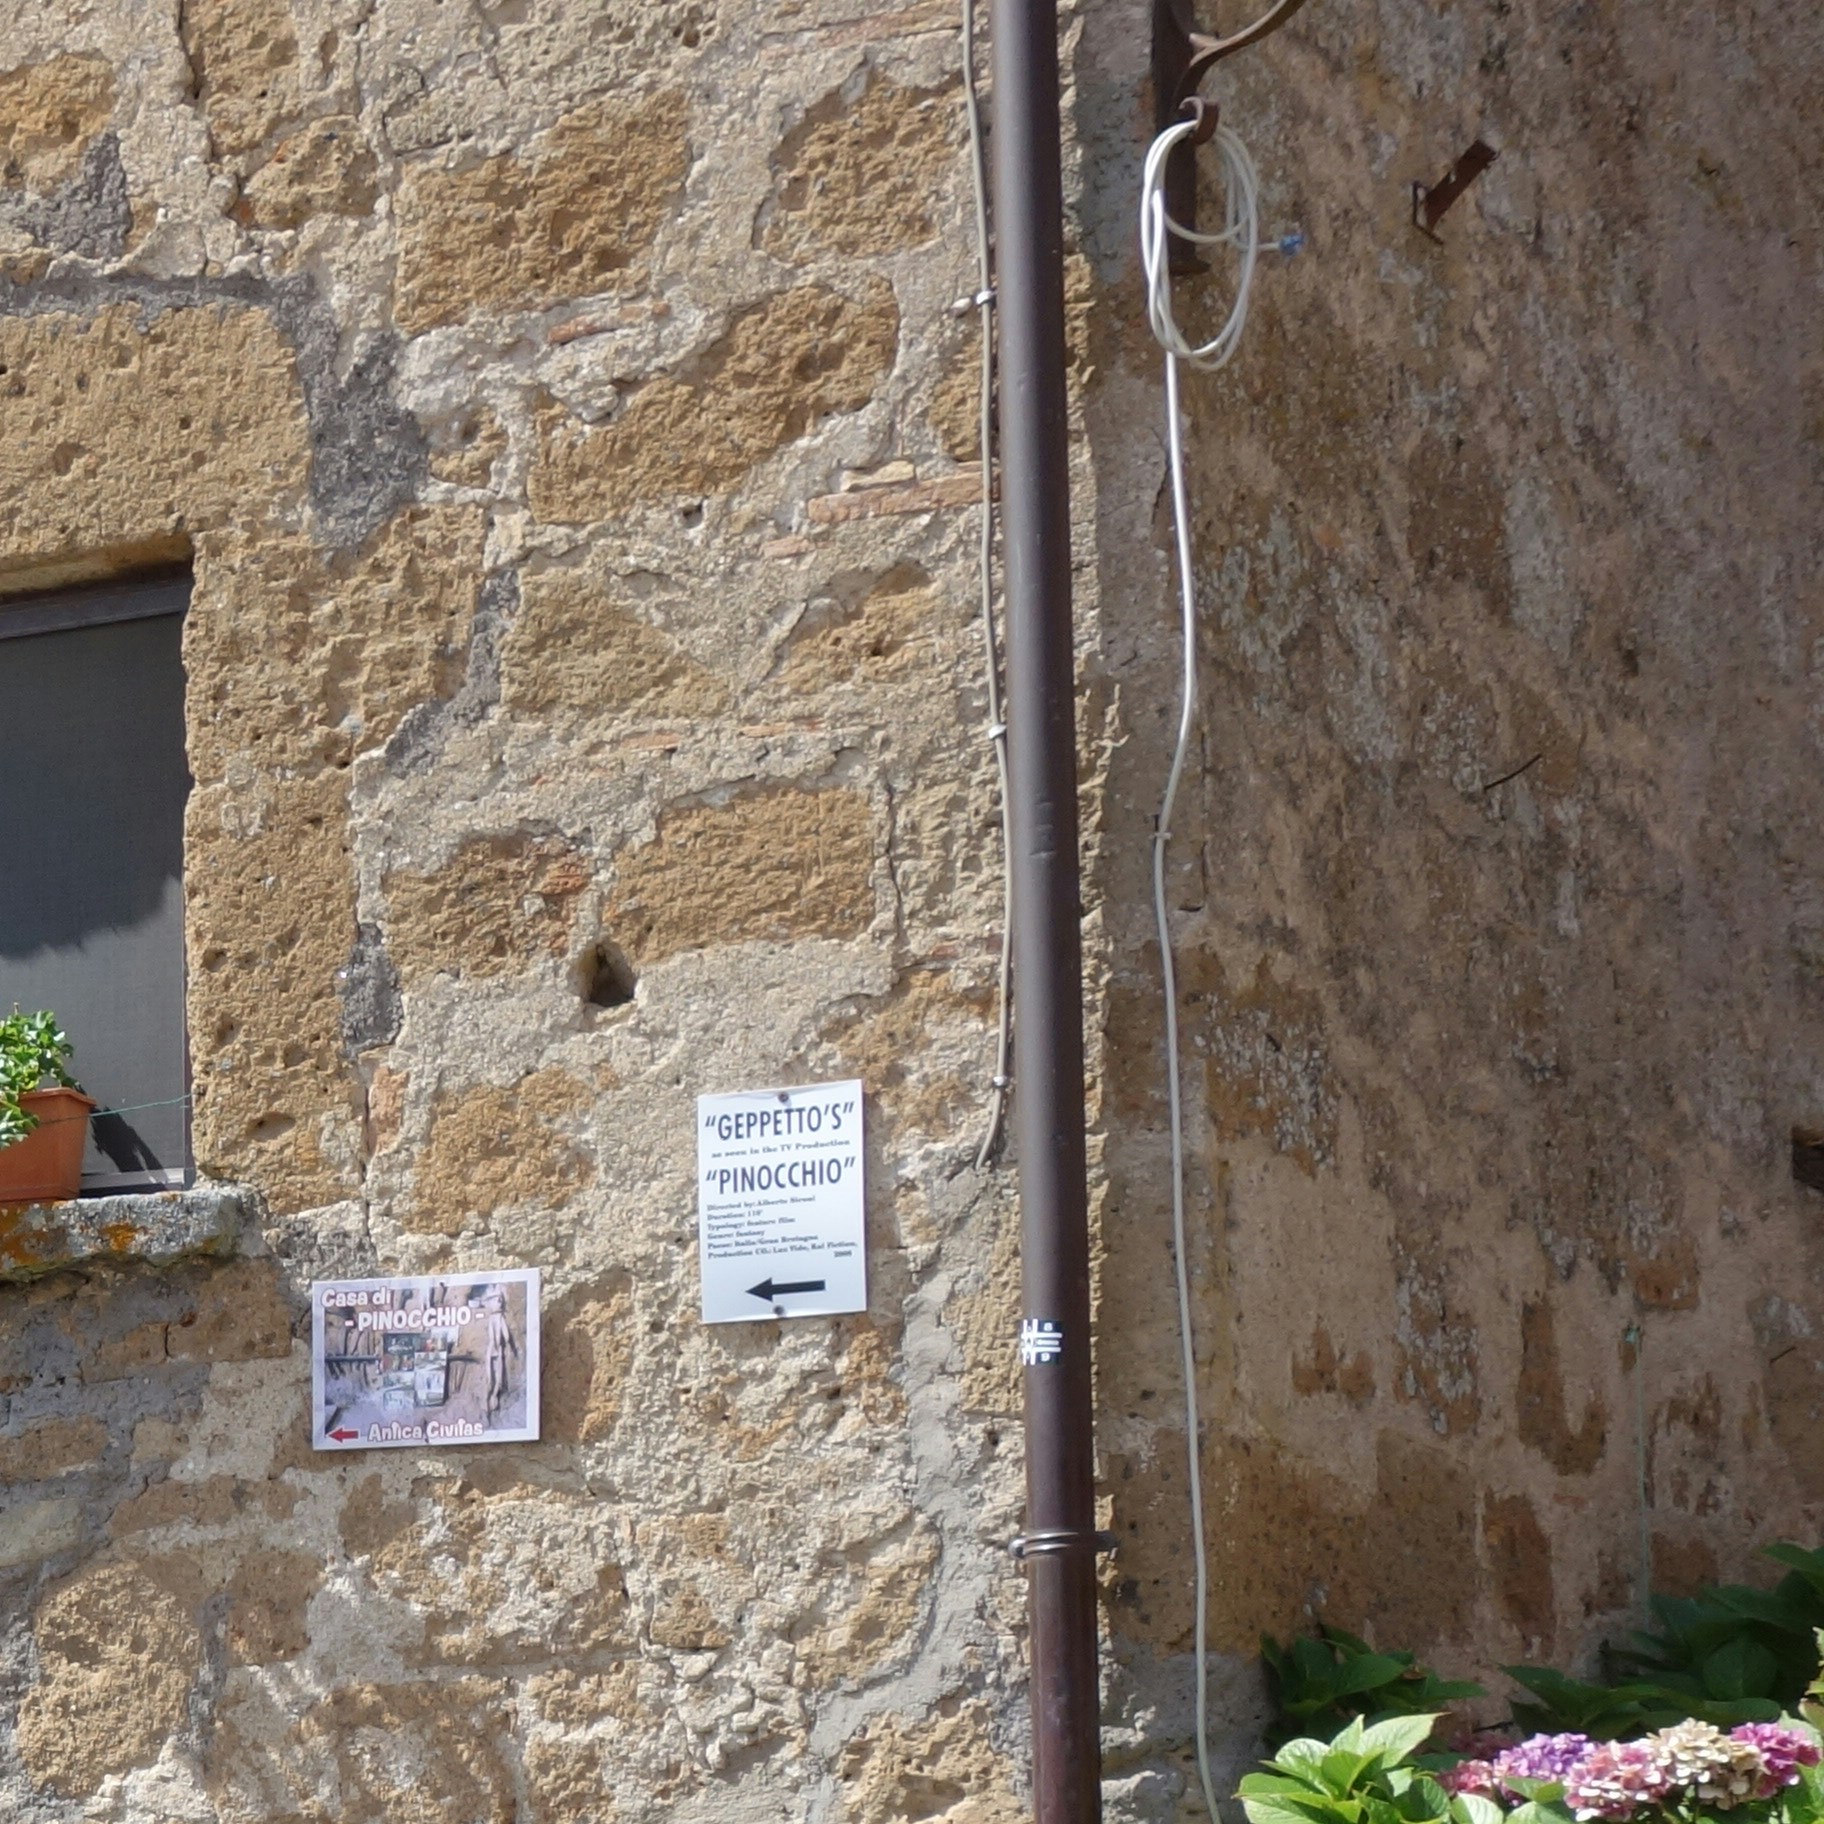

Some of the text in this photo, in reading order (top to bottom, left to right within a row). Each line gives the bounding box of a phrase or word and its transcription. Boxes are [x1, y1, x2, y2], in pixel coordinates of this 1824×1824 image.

[705, 1101, 854, 1141] "GEPPETTO'S"
[763, 1144, 778, 1152] the
[780, 1144, 793, 1152] TV
[795, 1138, 850, 1150] Production
[705, 1156, 856, 1194] "PINOCCHIO"
[321, 1286, 392, 1307] Casa di
[358, 1306, 471, 1331] PINOCCHIO
[367, 1418, 484, 1442] Antica Civitas
